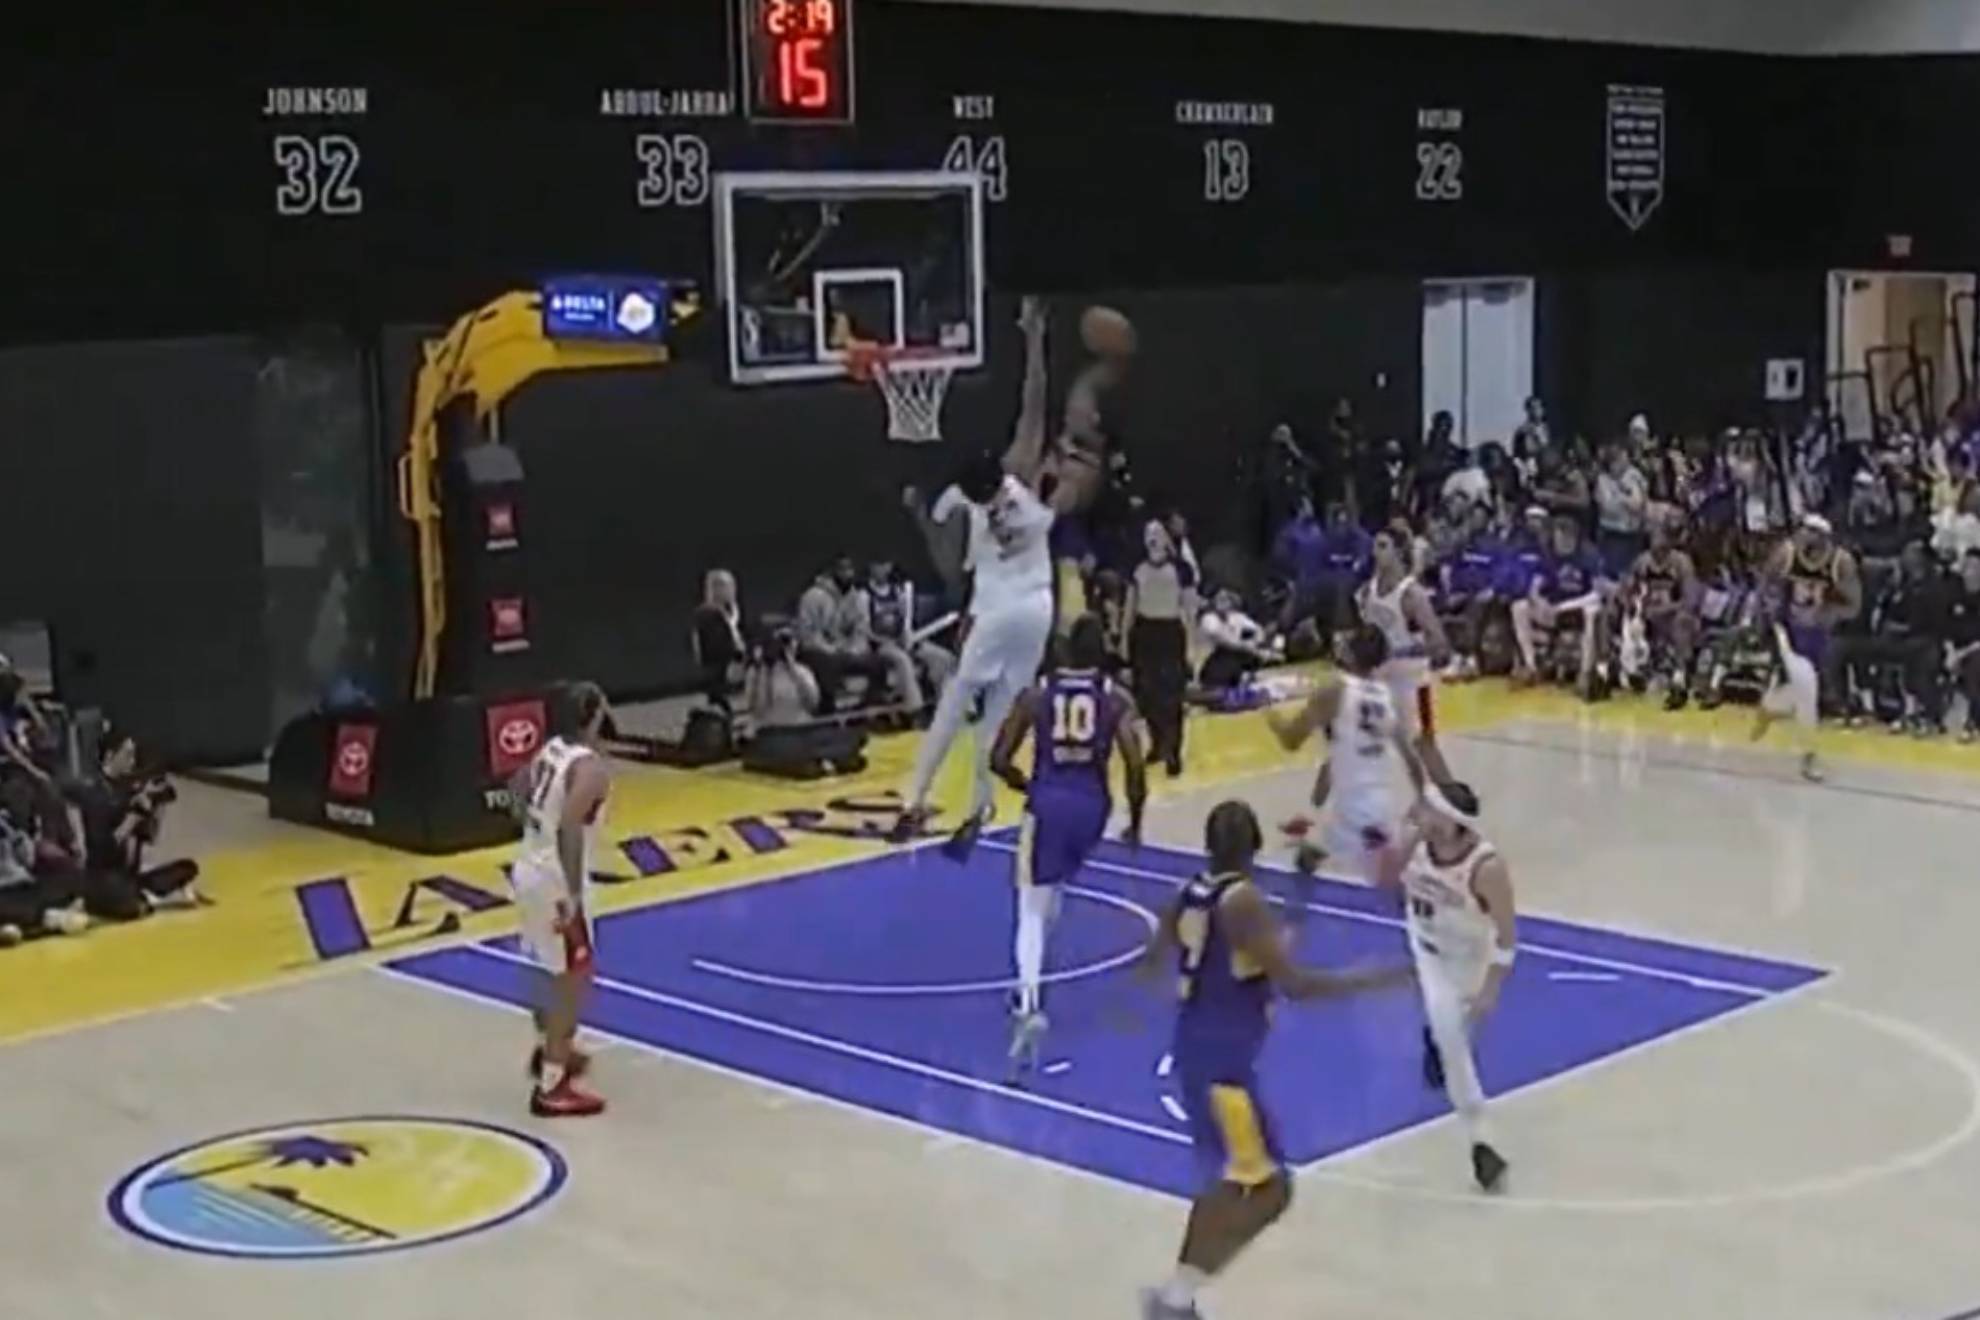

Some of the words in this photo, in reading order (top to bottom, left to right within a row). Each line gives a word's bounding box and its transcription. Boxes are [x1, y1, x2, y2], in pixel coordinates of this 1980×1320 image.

[768, 0, 834, 34] 2:19
[263, 88, 367, 114] JOHNSON
[779, 38, 828, 106] 15
[601, 89, 735, 115] ABDUL-JABBA
[953, 96, 994, 118] WEST
[274, 136, 362, 214] 32
[636, 134, 709, 206] 33
[943, 136, 1007, 201] 44
[1204, 139, 1249, 200] 13
[1416, 143, 1462, 199] 22
[1051, 693, 1096, 742] 10
[296, 788, 938, 959] LAERS
